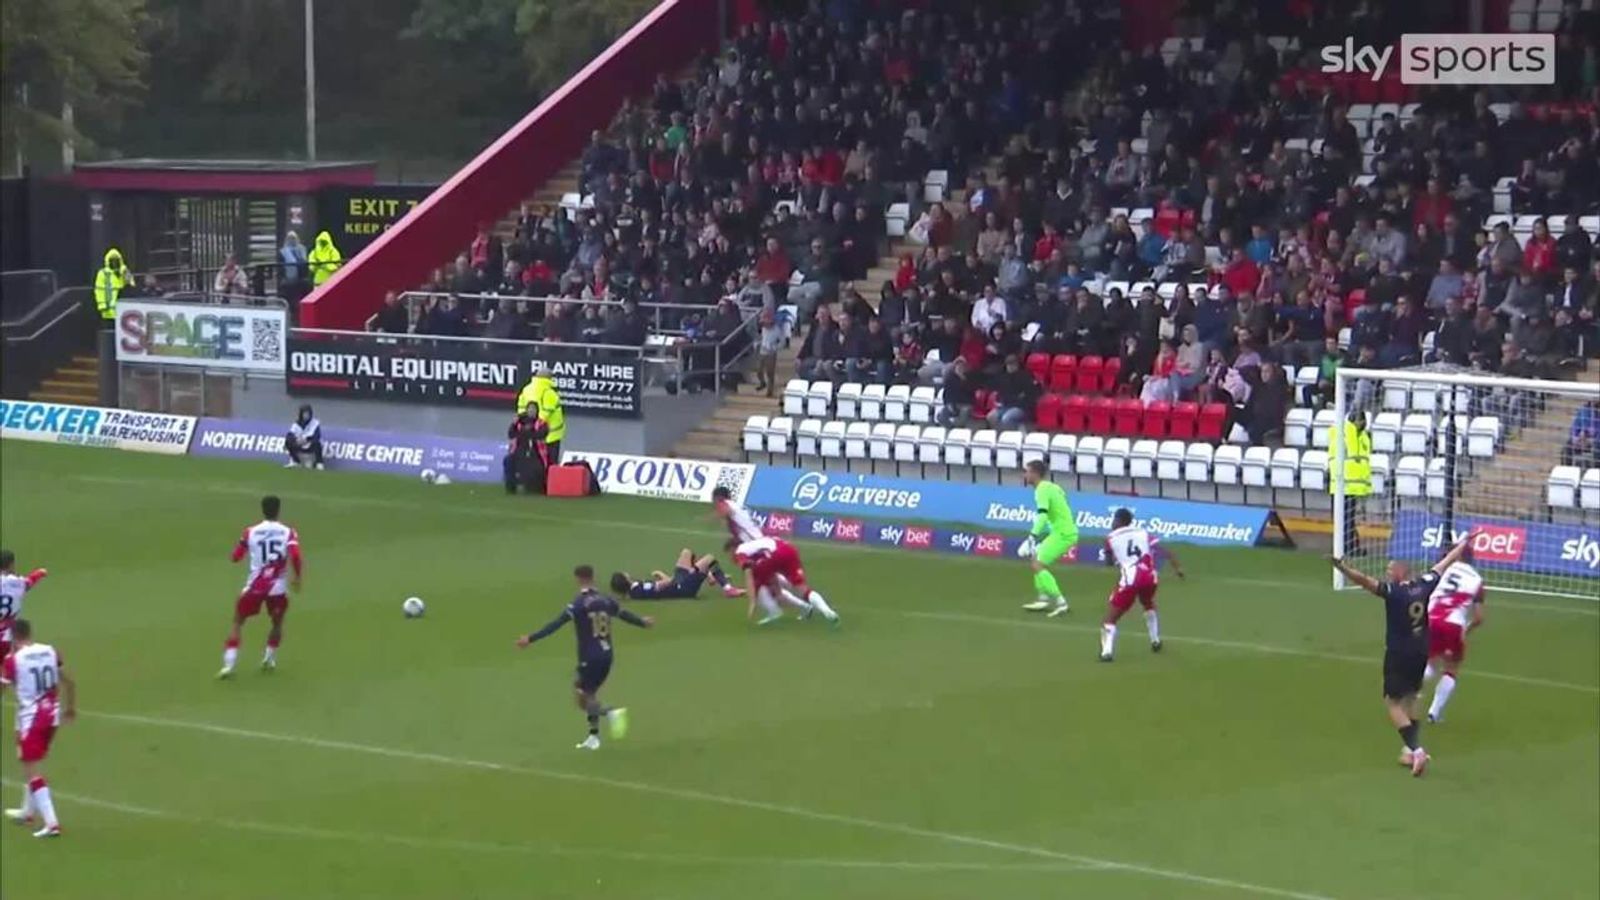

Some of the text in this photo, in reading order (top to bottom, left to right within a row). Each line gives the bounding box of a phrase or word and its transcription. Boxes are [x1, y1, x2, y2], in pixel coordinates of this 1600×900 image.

[349, 198, 399, 217] EXIT
[344, 223, 380, 234] KEEP
[120, 309, 246, 361] SPACE
[290, 351, 518, 385] ORBITAL EQUIPMENT
[593, 364, 634, 380] HIRE
[354, 380, 464, 396] LIMITED
[104, 411, 176, 430] TRANSPORT
[100, 425, 187, 445] WAREHOUSING
[200, 430, 424, 466] NORTH HER ISURE CENTRE
[616, 459, 709, 491] COINS
[828, 484, 921, 508] carverse
[770, 514, 793, 531] bet
[811, 518, 860, 538] sky bet
[986, 502, 1036, 522] Knebw
[1076, 511, 1114, 529] Used
[1148, 518, 1252, 541] Supermarket
[880, 525, 930, 545] sky bet
[950, 532, 1001, 551] sky bet
[1473, 527, 1519, 555] bet
[257, 540, 283, 564] 15
[1126, 539, 1141, 557] 4
[1560, 534, 1600, 569] sky
[587, 610, 610, 638] 18
[1408, 601, 1425, 626] 9
[29, 665, 56, 694] 10
